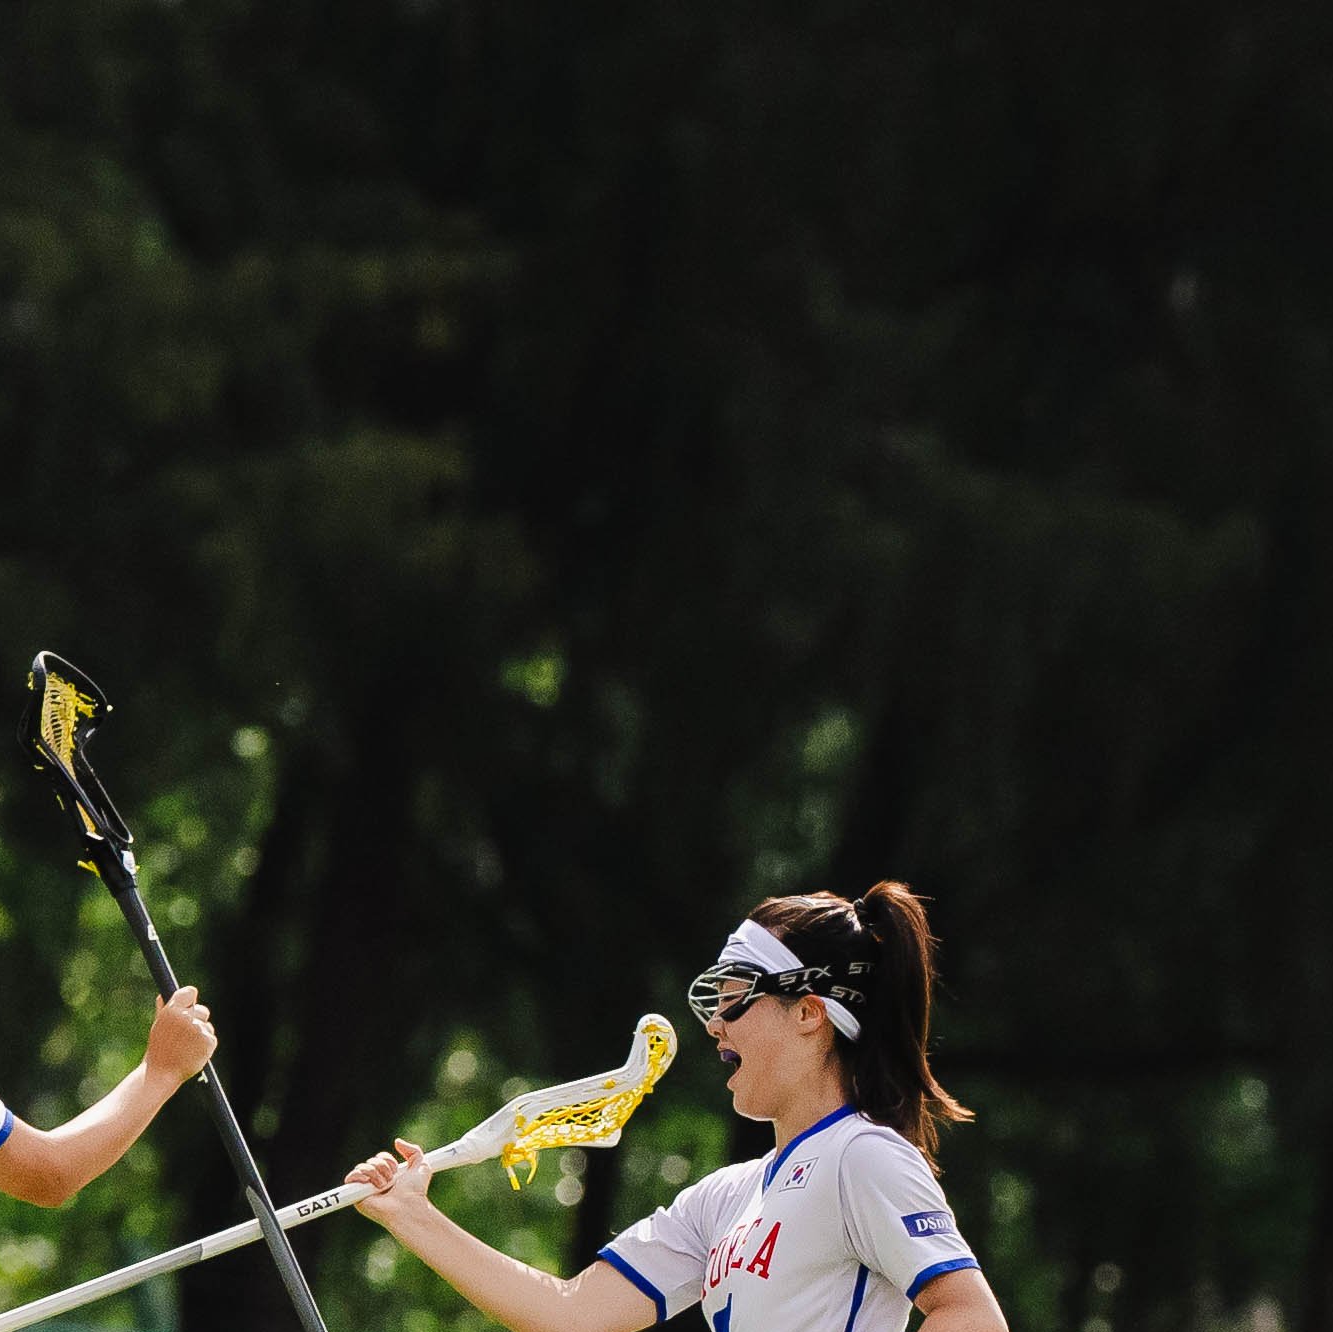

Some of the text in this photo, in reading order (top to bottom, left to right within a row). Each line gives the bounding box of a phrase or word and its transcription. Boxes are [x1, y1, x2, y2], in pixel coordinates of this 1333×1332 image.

[778, 965, 832, 985] STX
[296, 1192, 340, 1218] GAIT
[702, 1217, 782, 1300] OREA
